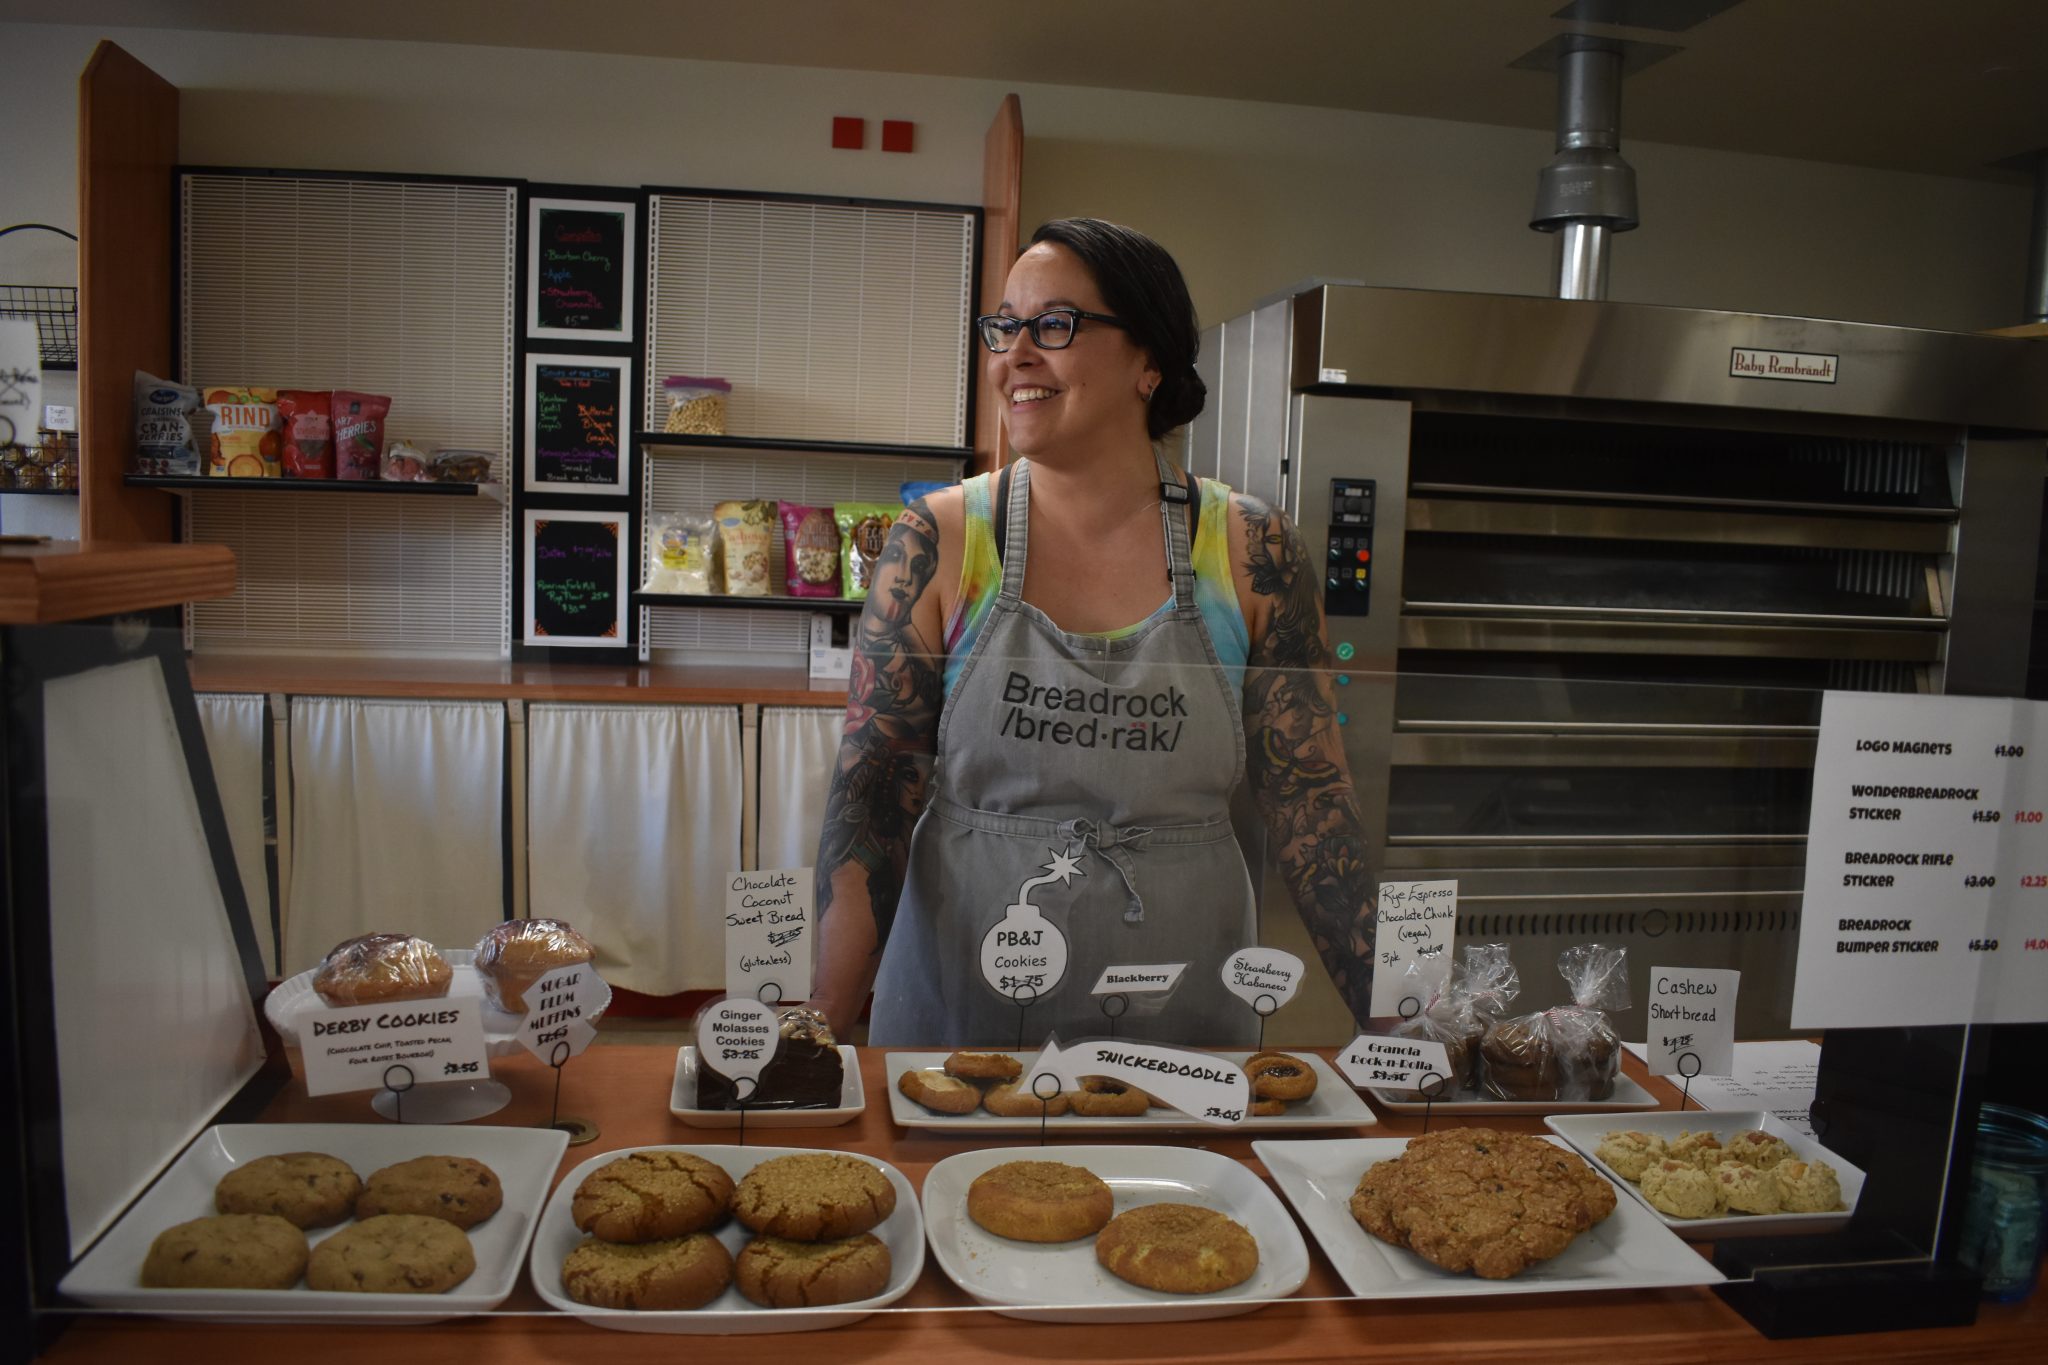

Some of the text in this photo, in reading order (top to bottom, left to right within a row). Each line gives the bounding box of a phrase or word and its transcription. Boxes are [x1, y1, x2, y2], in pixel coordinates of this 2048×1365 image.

[1734, 352, 1765, 375] Baby
[221, 406, 271, 429] RIND
[334, 416, 352, 426] ART
[141, 422, 184, 434] CRAN-
[1002, 671, 1188, 718] Breadrock
[1856, 740, 2024, 757] LOGO MAGNETS $1.00
[1852, 785, 1979, 800] WONDERBREADROCK
[1849, 807, 2043, 823] STICKER $1.50 $1.00
[1845, 852, 1953, 866] BREADROCK RIFLE
[731, 873, 798, 891] Chocolate
[1843, 874, 2048, 888] STICKER $3.00 $2.25
[742, 890, 794, 908] Coconut
[1379, 884, 1453, 908] Rye Espresso
[726, 907, 806, 926] Sweet Bread
[1377, 905, 1454, 923] Chocolate Chunk
[1838, 919, 1912, 931] BREADROCK
[997, 930, 1043, 946] PB&J
[1398, 924, 1431, 944] (vegan)
[1836, 941, 1890, 953] BUMPER
[1891, 940, 1939, 953] STICKER
[740, 950, 792, 972] (glutenless)
[994, 954, 1047, 968] Cookies
[1233, 957, 1292, 981] Strawberry
[541, 973, 581, 993] SUGAR
[1106, 974, 1169, 985] Blackberry
[1233, 971, 1287, 992] Habanero
[1657, 977, 1717, 995] Cashew
[541, 991, 575, 1011] PLUM
[313, 1010, 460, 1037] DERBY COOKIES
[528, 1005, 582, 1032] MUFFINS
[720, 1010, 763, 1022] Ginger
[713, 1023, 769, 1033] Molasses
[327, 1044, 371, 1056] (CHOCOLATE
[374, 1041, 393, 1051] CHIP,
[395, 1039, 425, 1047] TOASTED
[716, 1036, 765, 1046] Cookies
[1368, 1043, 1421, 1056] Granola
[349, 1050, 435, 1065] FOUR ROSES BOURBON)
[722, 1048, 760, 1060] $3.25
[1097, 1050, 1237, 1085] SNICKERDOODLE
[1350, 1055, 1433, 1071] Rock-n-Rolla
